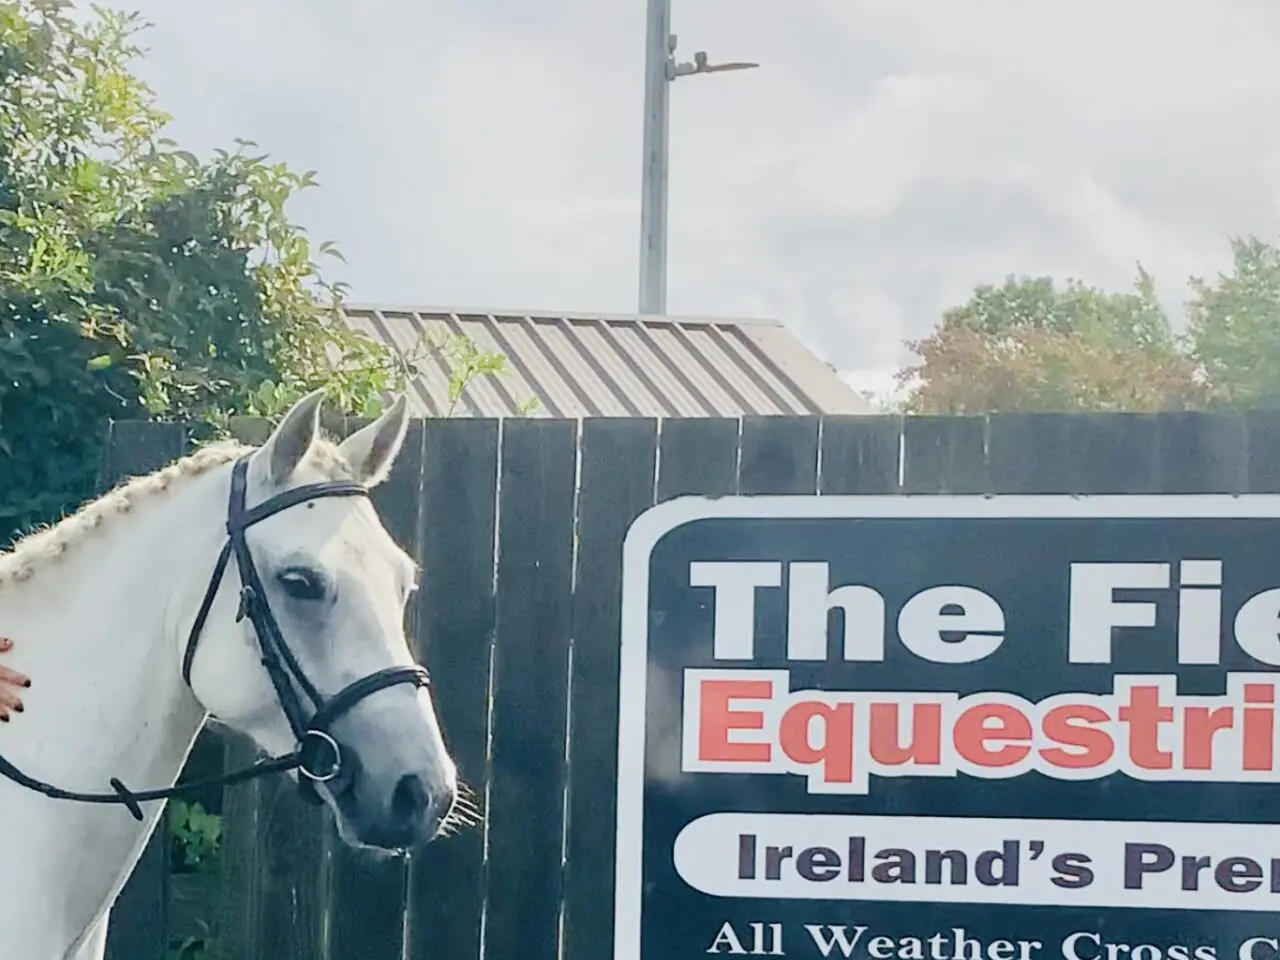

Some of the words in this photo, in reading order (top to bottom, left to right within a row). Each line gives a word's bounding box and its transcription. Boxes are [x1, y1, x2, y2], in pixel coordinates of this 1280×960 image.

[689, 561, 1005, 664] The
[698, 679, 1275, 783] Equestri
[736, 834, 1095, 889] Ireland's
[1123, 842, 1280, 894] Pre
[705, 921, 785, 956] All
